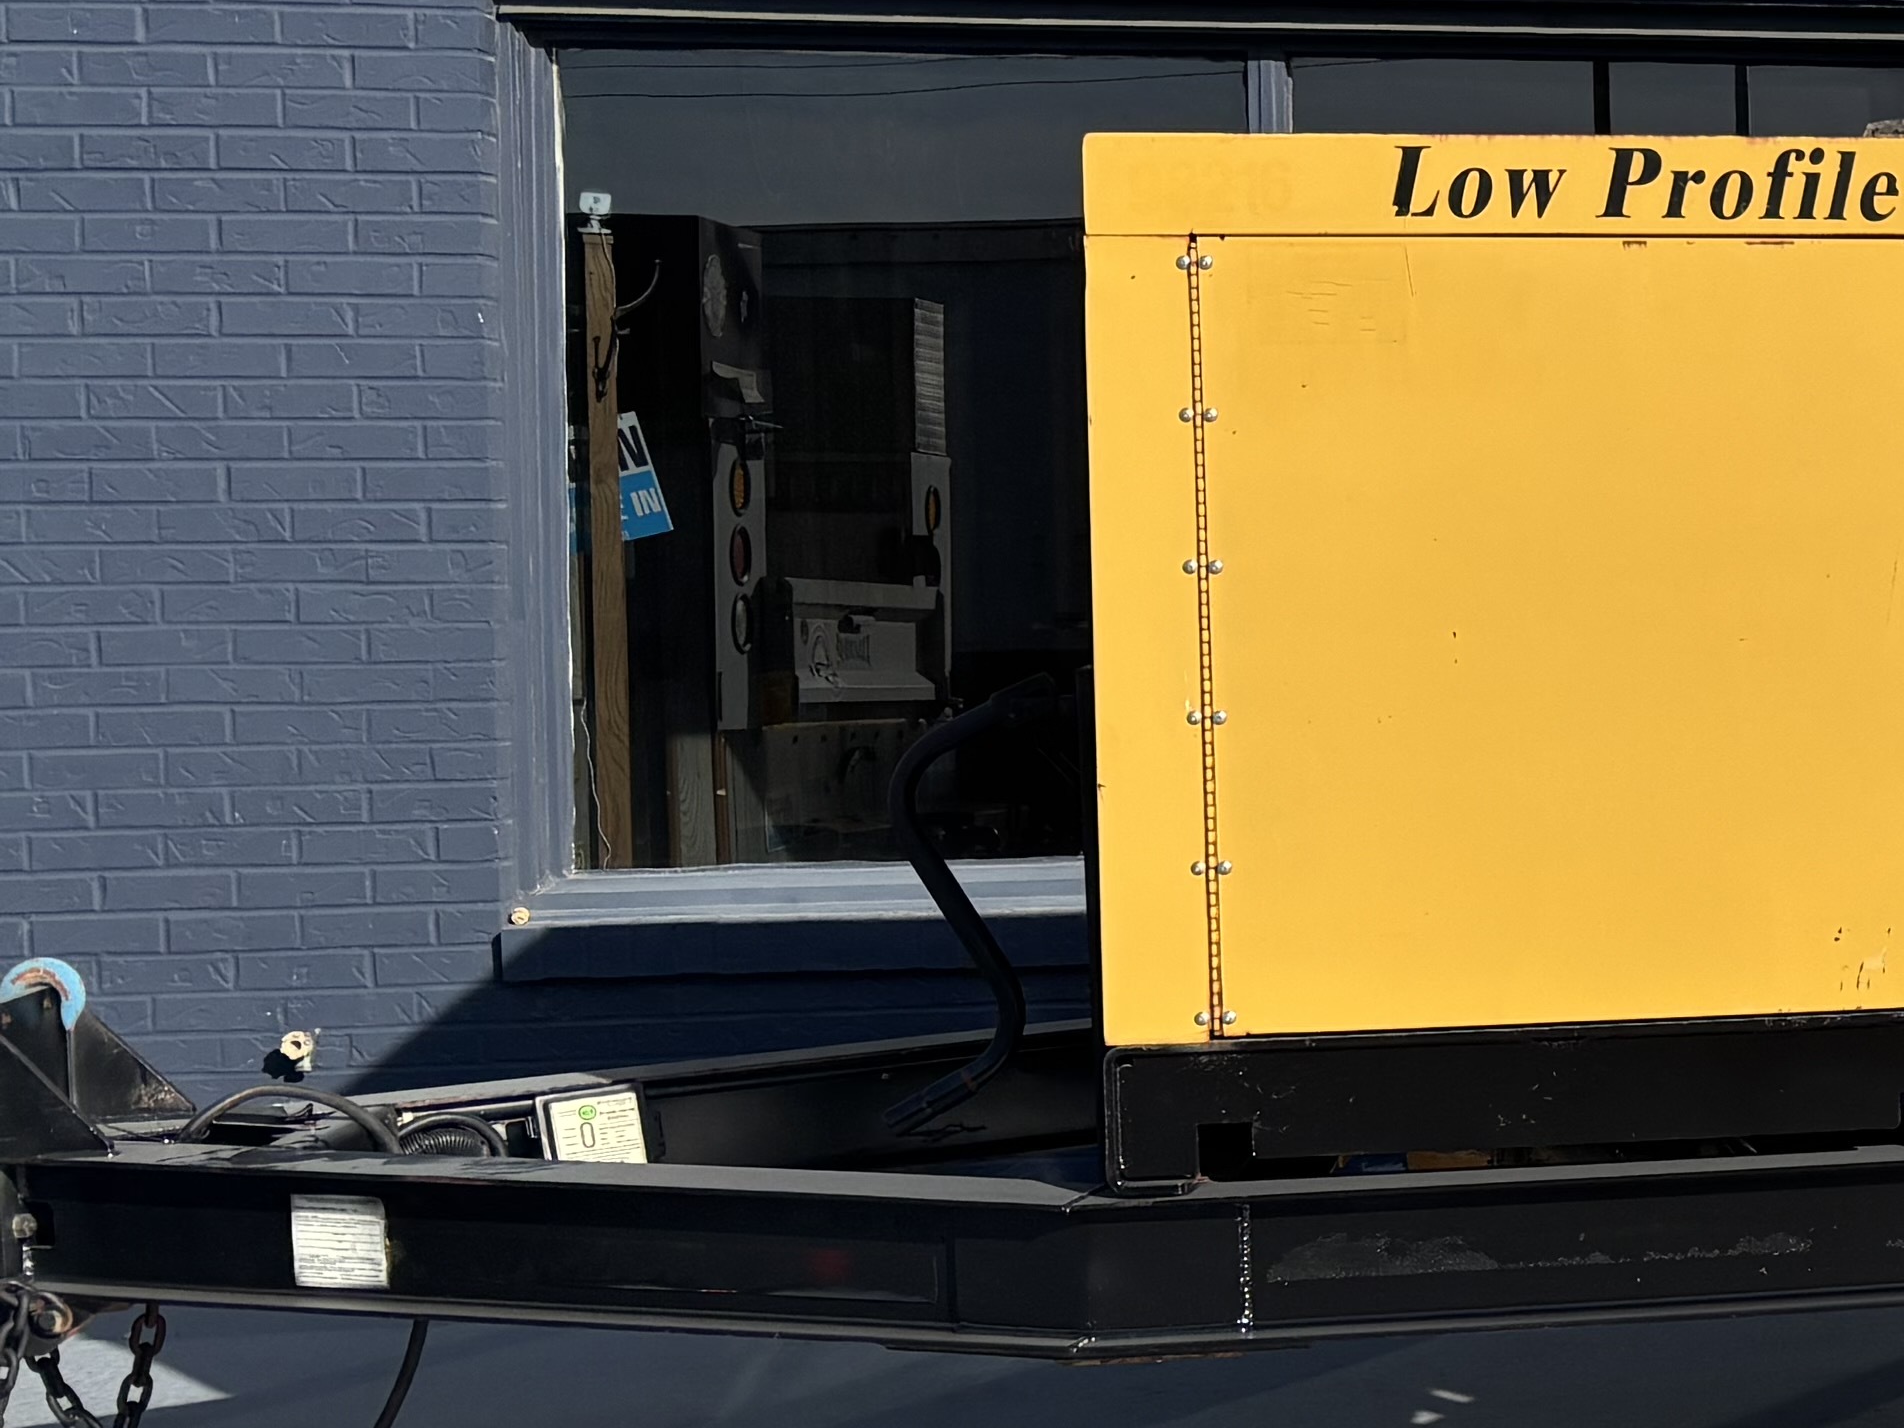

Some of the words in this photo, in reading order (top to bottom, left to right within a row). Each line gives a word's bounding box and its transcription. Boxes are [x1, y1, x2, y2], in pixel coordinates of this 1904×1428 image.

[1392, 145, 1568, 219] Low
[1595, 147, 1900, 224] Profile
[630, 487, 662, 518] IN
